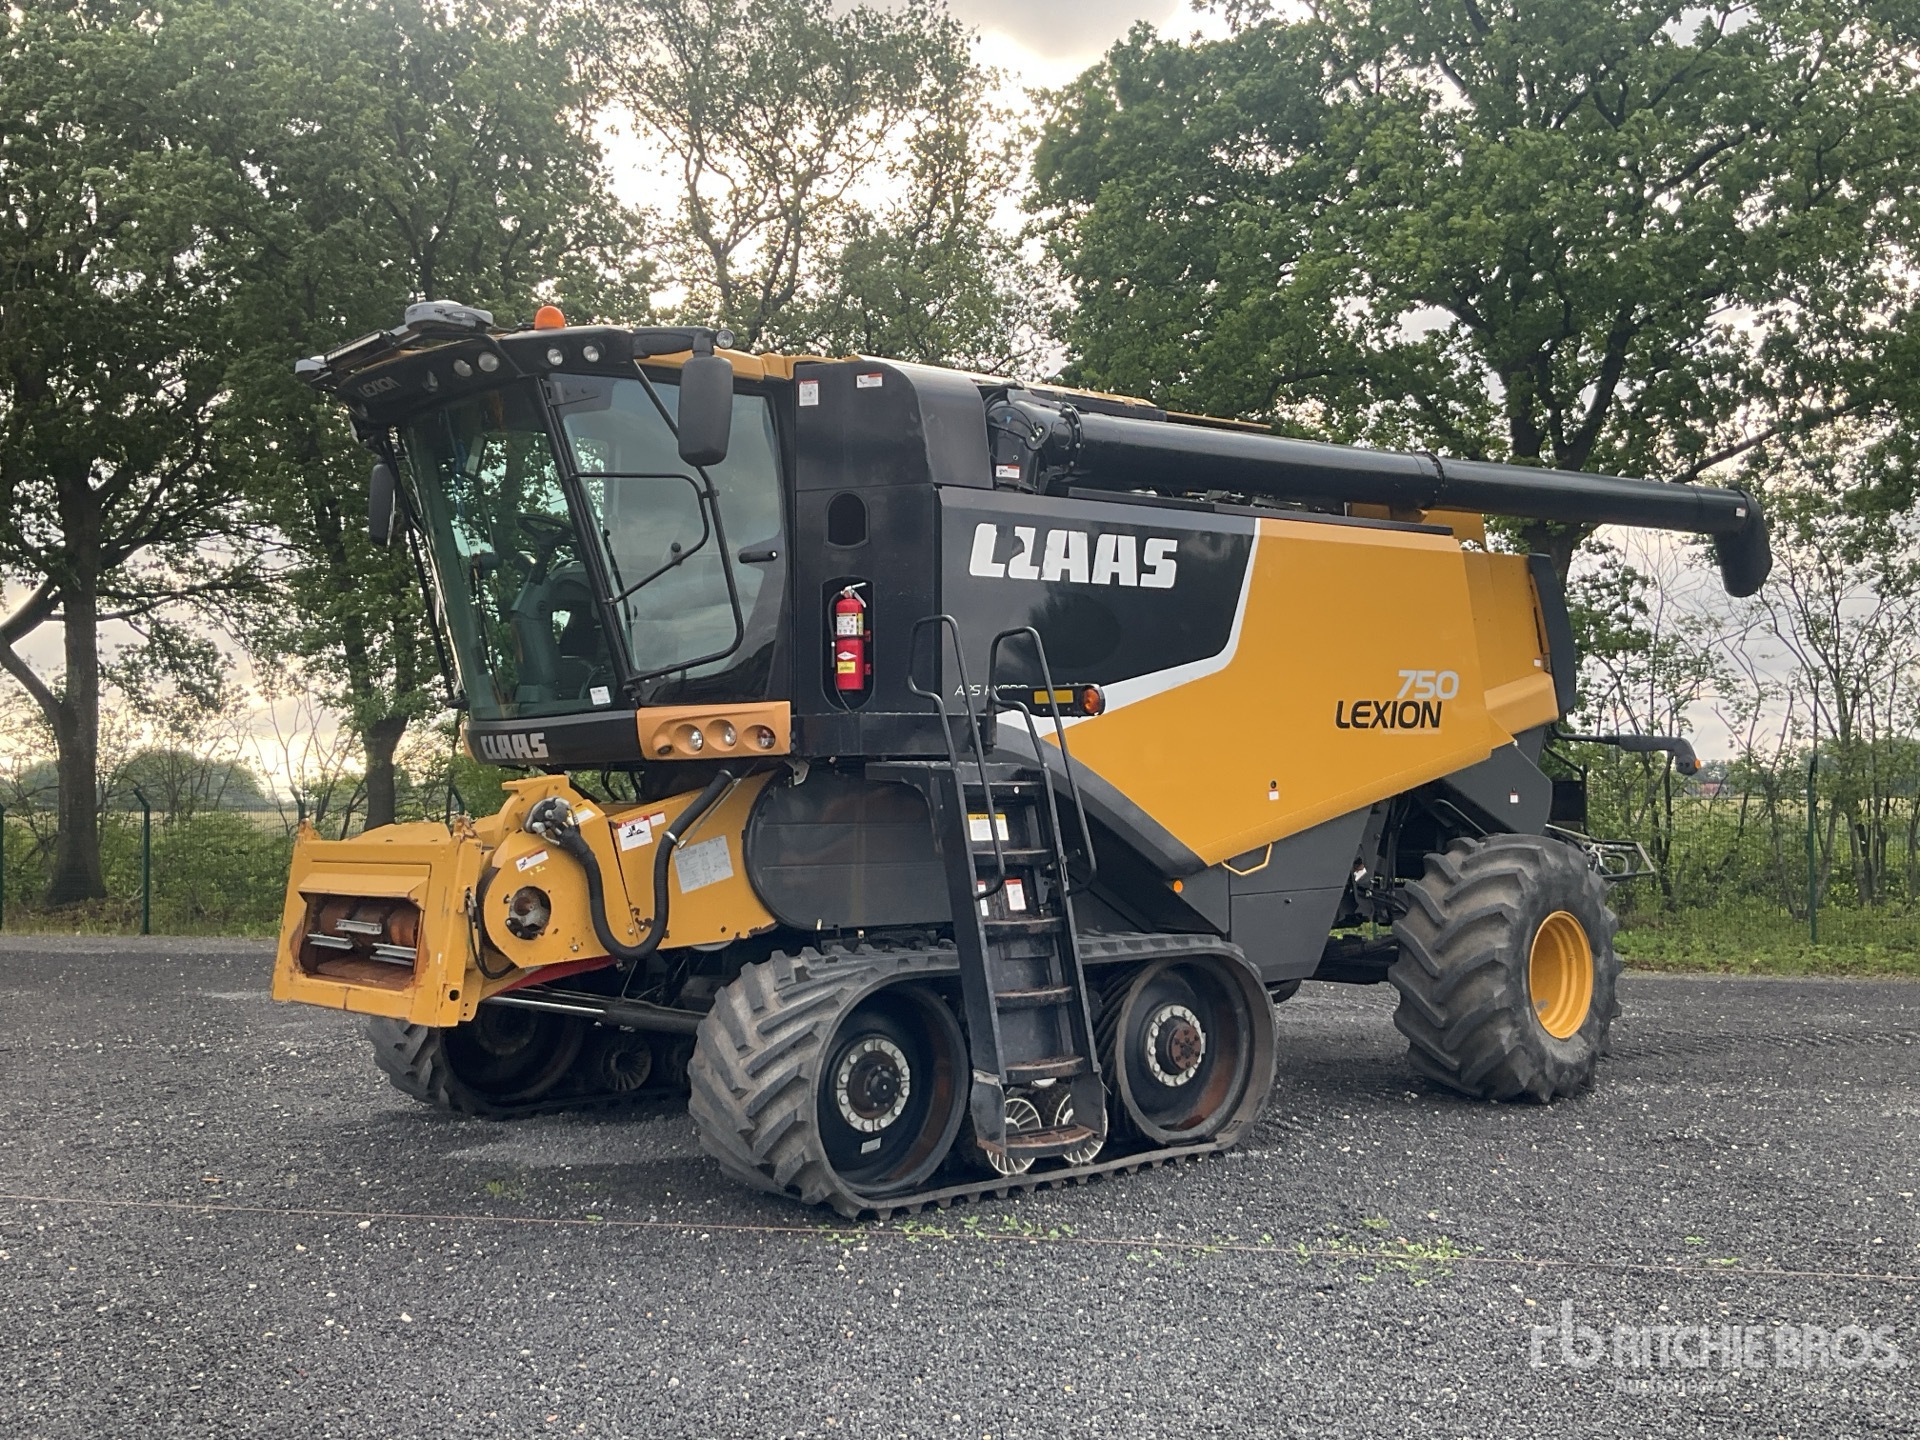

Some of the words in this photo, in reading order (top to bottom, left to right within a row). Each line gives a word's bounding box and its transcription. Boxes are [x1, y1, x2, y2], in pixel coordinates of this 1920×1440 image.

[1396, 669, 1460, 700] 750
[1335, 700, 1443, 729] LEXION
[480, 732, 550, 760] CLAAS
